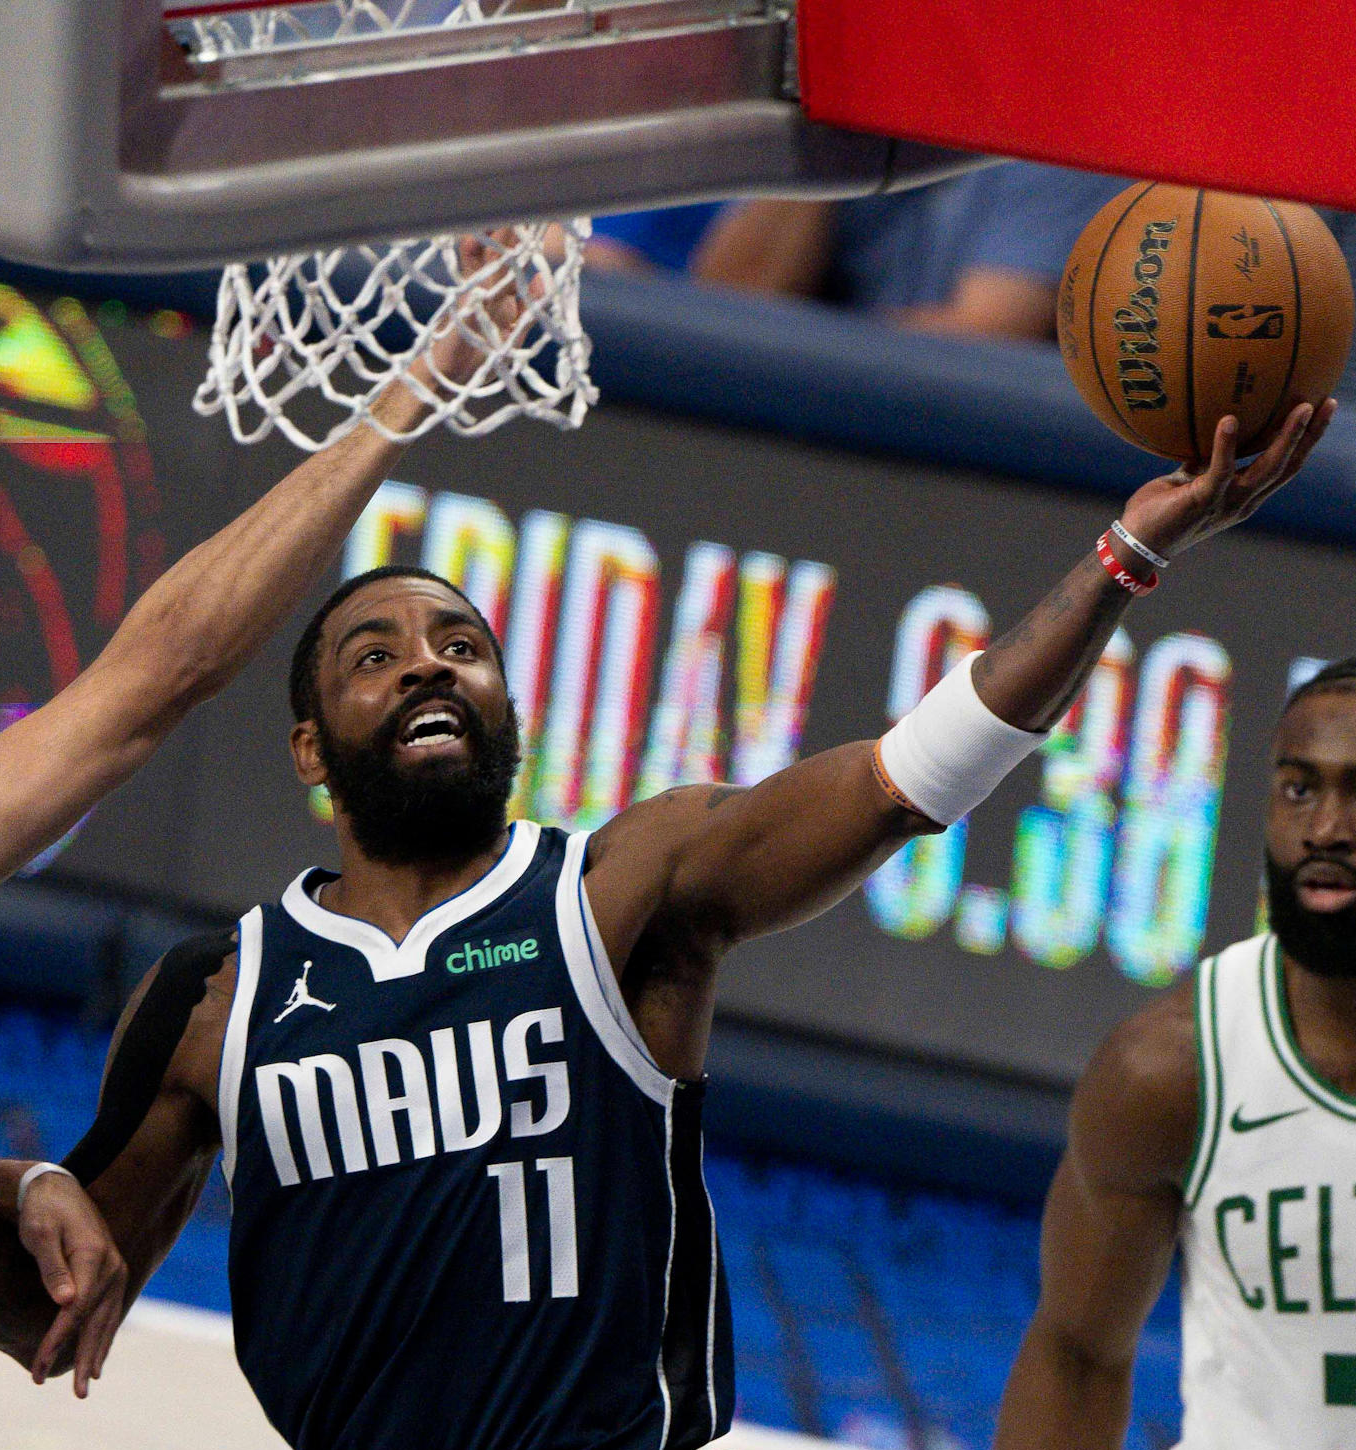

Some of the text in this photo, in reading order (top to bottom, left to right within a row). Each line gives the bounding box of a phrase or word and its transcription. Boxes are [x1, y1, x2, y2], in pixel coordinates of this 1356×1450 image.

[1113, 218, 1178, 412] Wilson
[307, 478, 839, 830] RIDAY
[446, 938, 539, 975] chime
[255, 1007, 571, 1187] MAVS
[487, 1157, 579, 1302] 11
